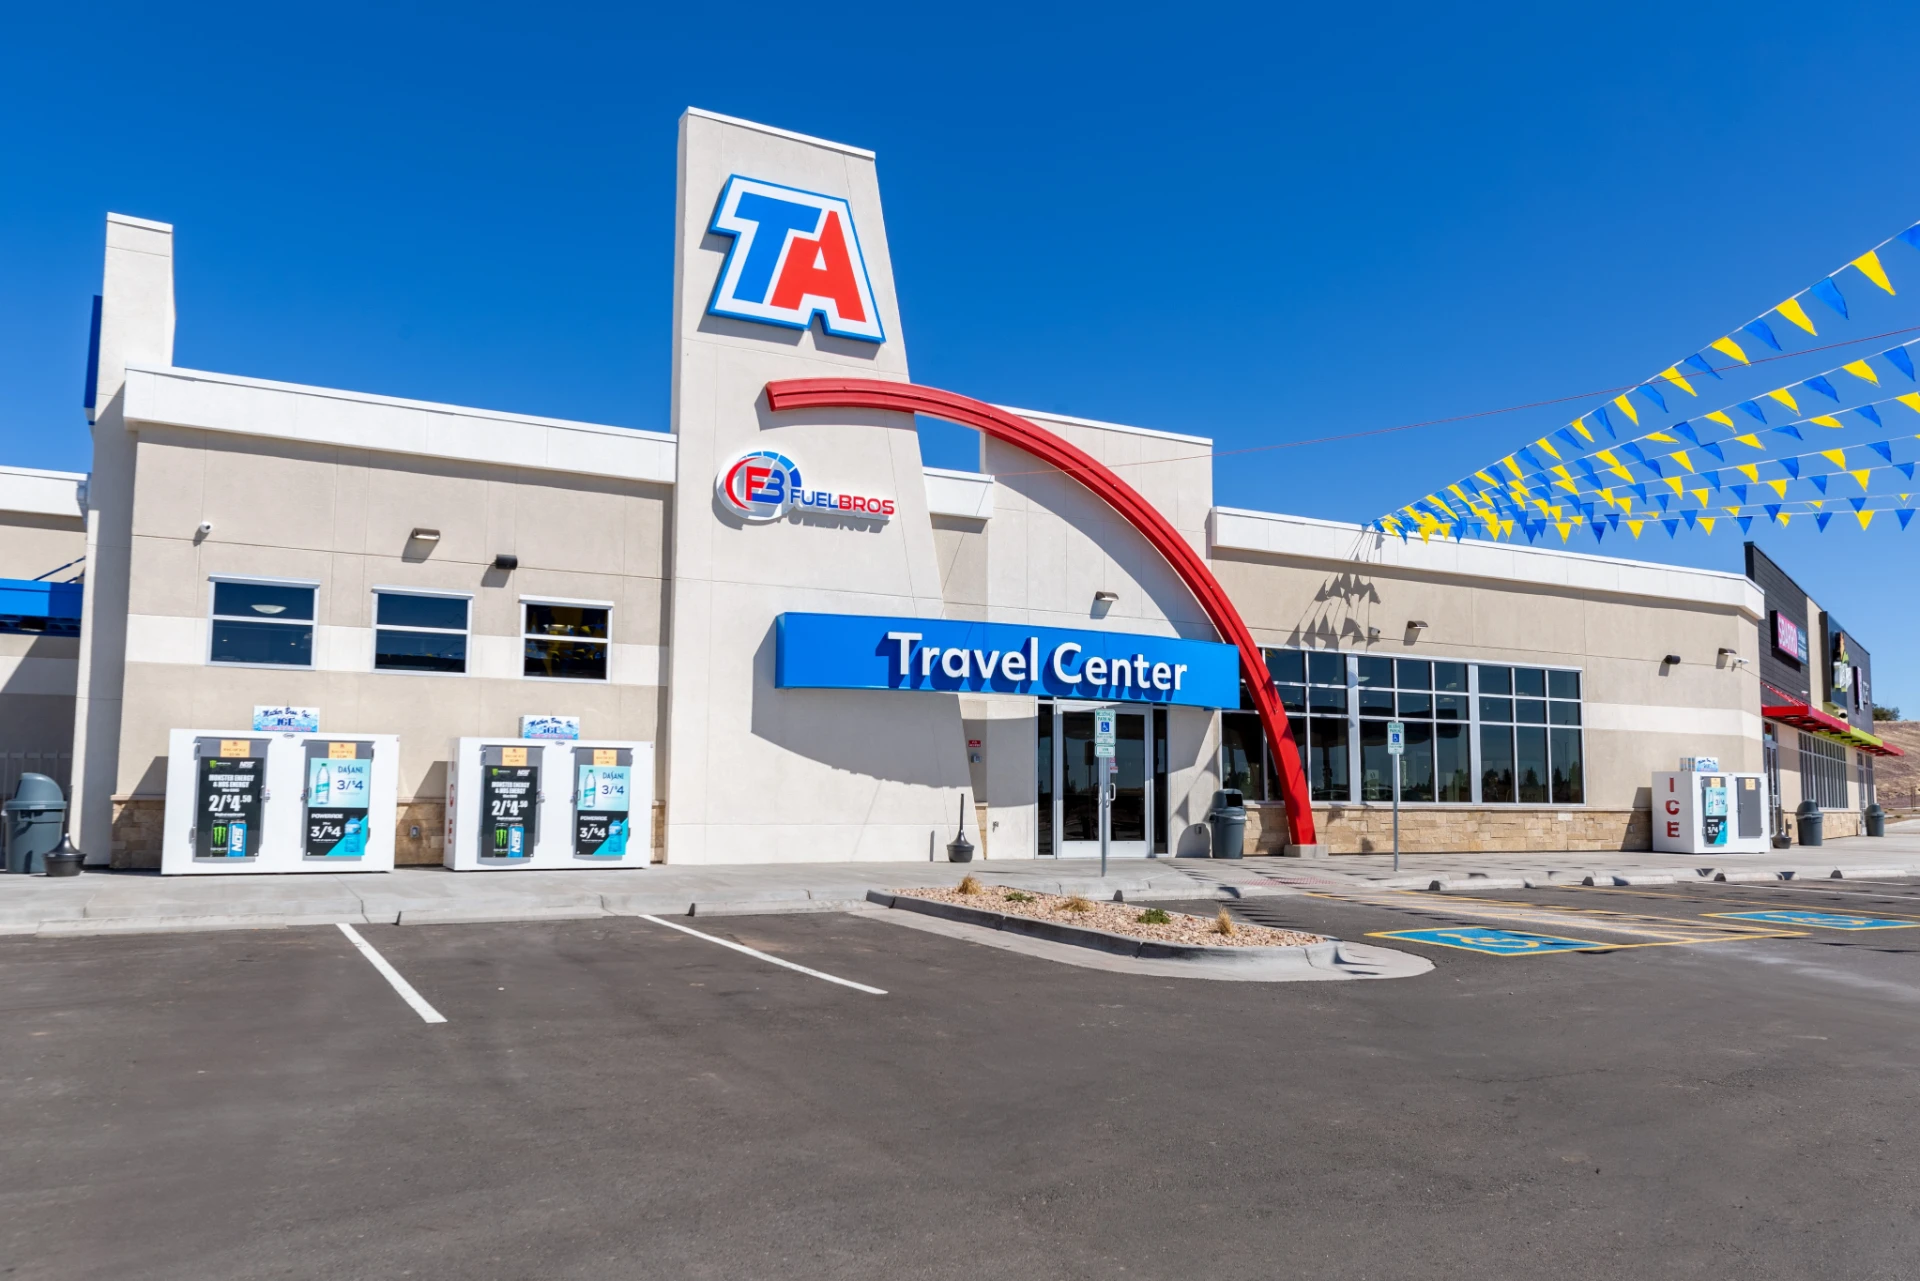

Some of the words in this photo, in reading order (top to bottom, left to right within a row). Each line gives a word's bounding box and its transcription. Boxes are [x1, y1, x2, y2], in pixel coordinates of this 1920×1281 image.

[733, 191, 867, 323] TA
[790, 488, 896, 515] FUELBROS
[887, 631, 1039, 682] Travel
[1053, 641, 1188, 691] Center
[208, 774, 234, 782] MONSTER
[234, 774, 255, 782] ENERGY
[1665, 777, 1680, 838] ICE
